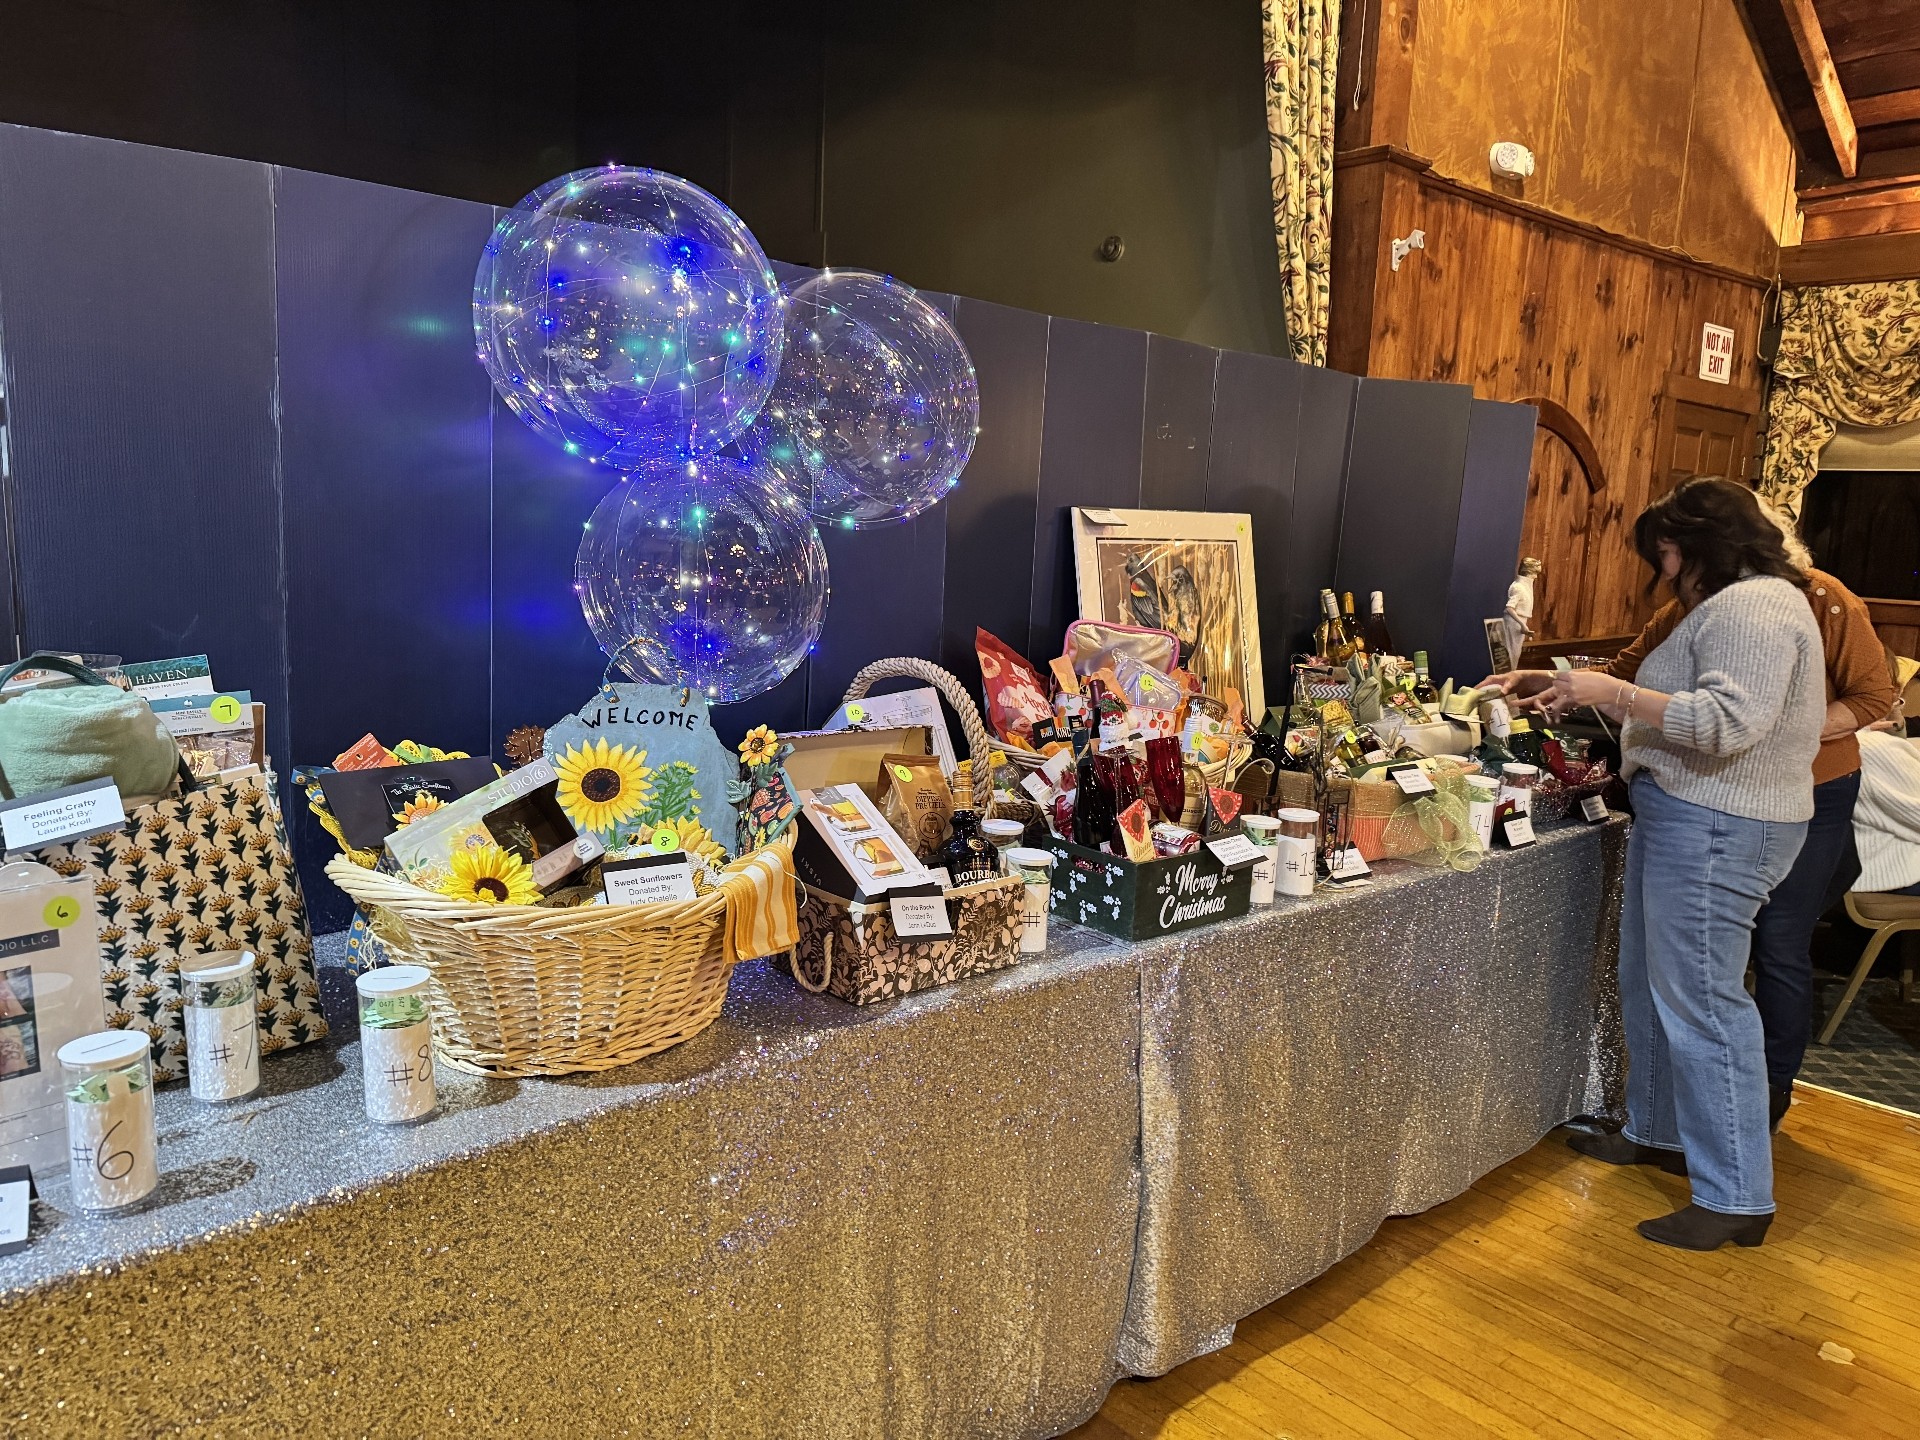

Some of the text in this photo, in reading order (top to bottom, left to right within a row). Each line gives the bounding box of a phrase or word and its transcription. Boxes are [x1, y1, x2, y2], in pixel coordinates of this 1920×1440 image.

[1706, 332, 1731, 354] NOT AN
[1708, 355, 1724, 375] EXIT
[136, 668, 188, 685] HAVEN
[581, 707, 699, 732] WELCOME
[487, 775, 533, 804] STUDIO
[24, 800, 97, 822] Feeling Crafty
[32, 809, 93, 829] Donated By:
[37, 817, 91, 836] Laura Kroll
[660, 836, 670, 846] 8
[614, 873, 683, 887] Sweet Sunflowers
[1175, 861, 1219, 896] Merry
[629, 884, 673, 896] Donated By:
[56, 905, 69, 919] 6
[1159, 895, 1228, 929] Christmas
[208, 1019, 254, 1070] #7
[383, 1043, 432, 1087] #8
[72, 1119, 135, 1181] #6
